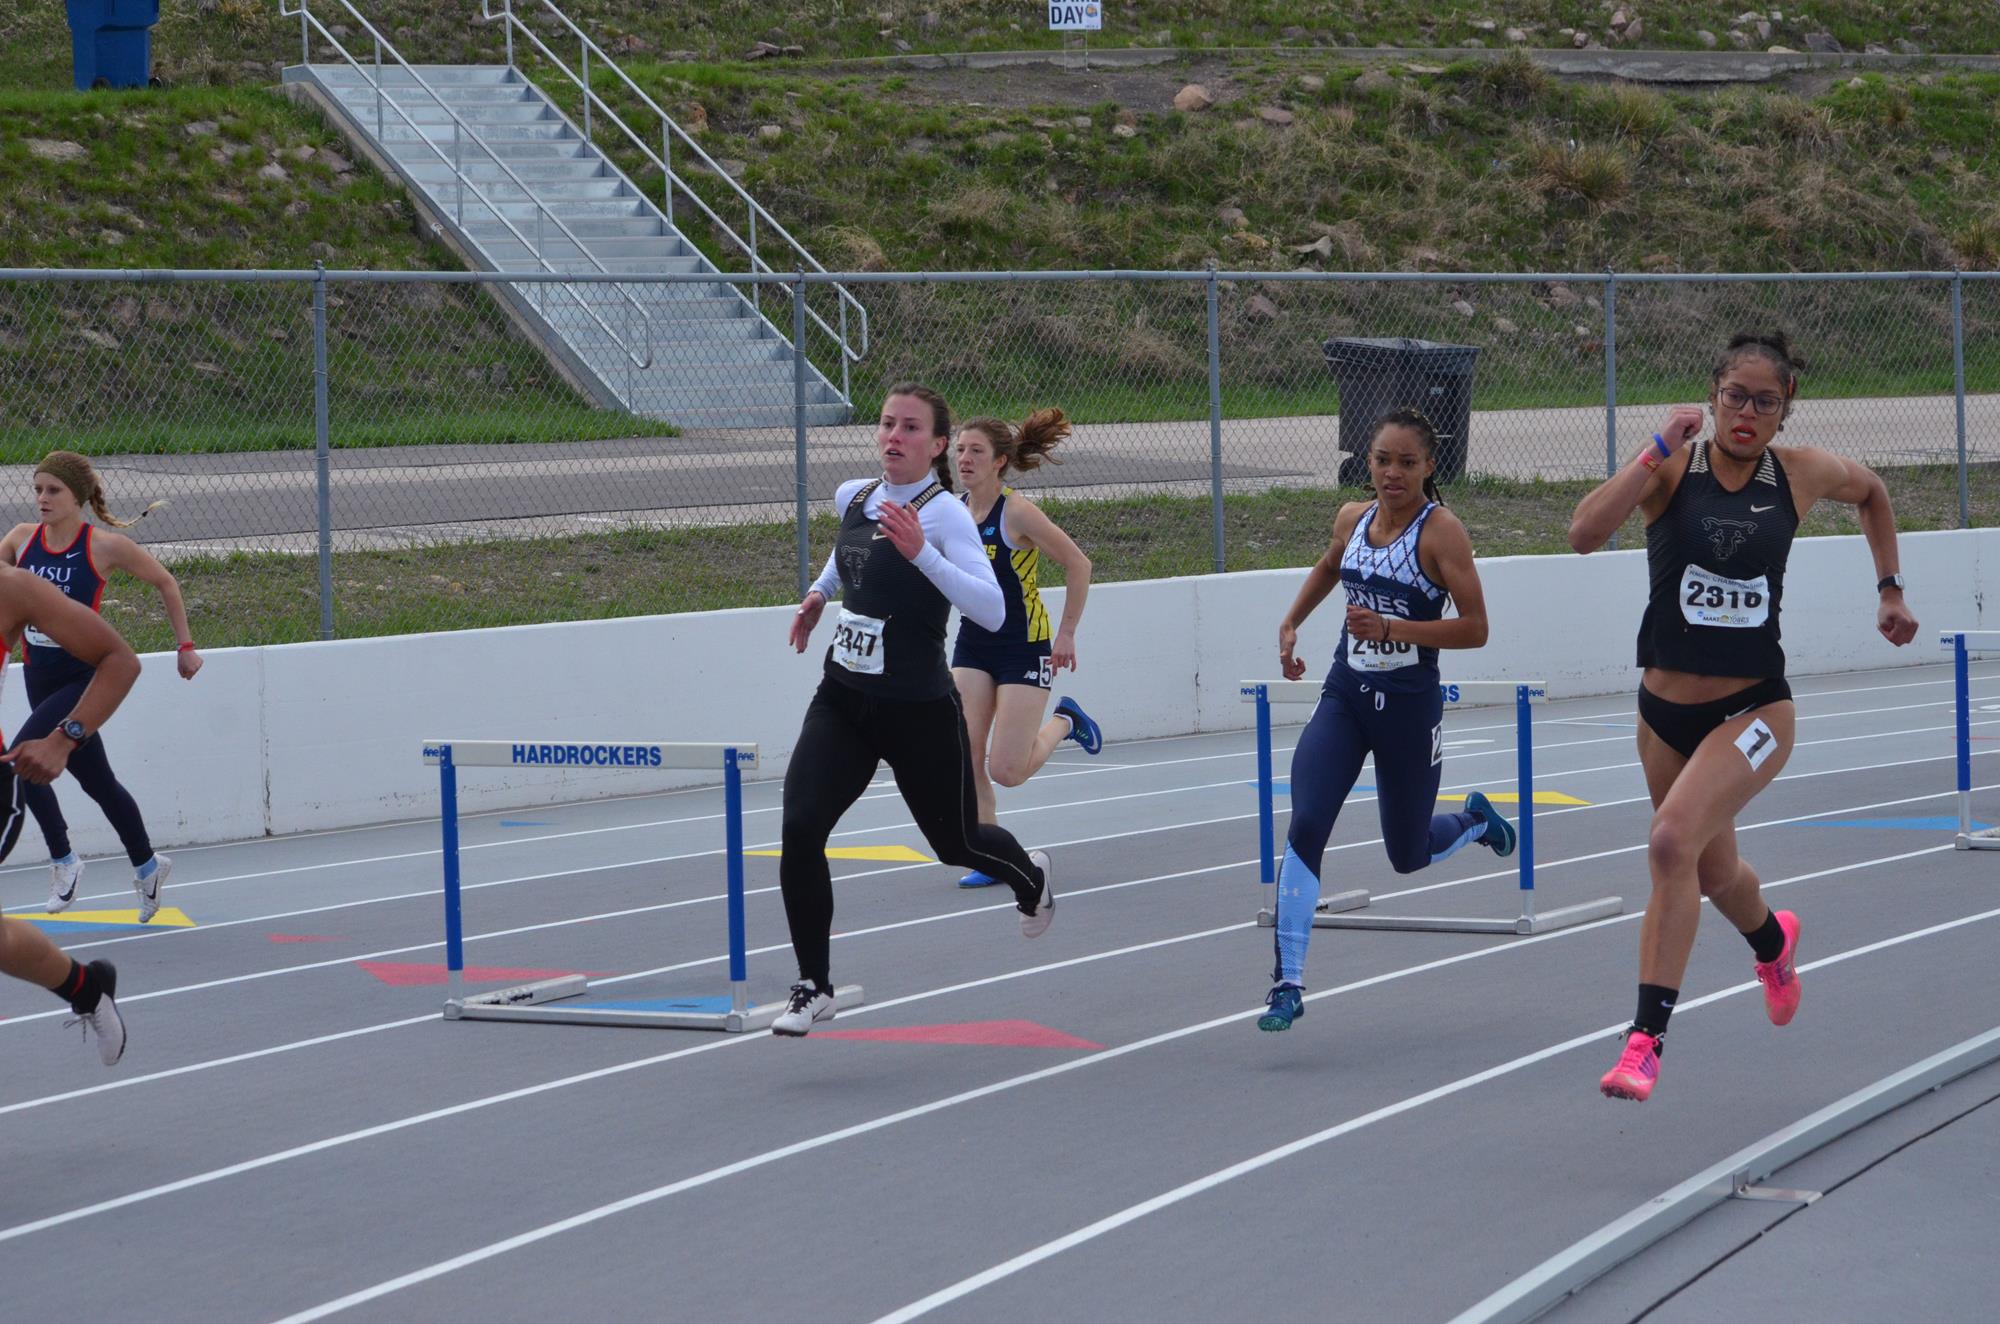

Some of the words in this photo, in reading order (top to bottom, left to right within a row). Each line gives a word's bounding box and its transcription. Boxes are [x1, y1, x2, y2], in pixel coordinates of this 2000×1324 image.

[1051, 6, 1083, 24] DAY
[1344, 587, 1410, 617] INES
[1041, 658, 1051, 686] 5
[512, 744, 662, 767] HARDROCKERS
[1746, 728, 1771, 761] 1
